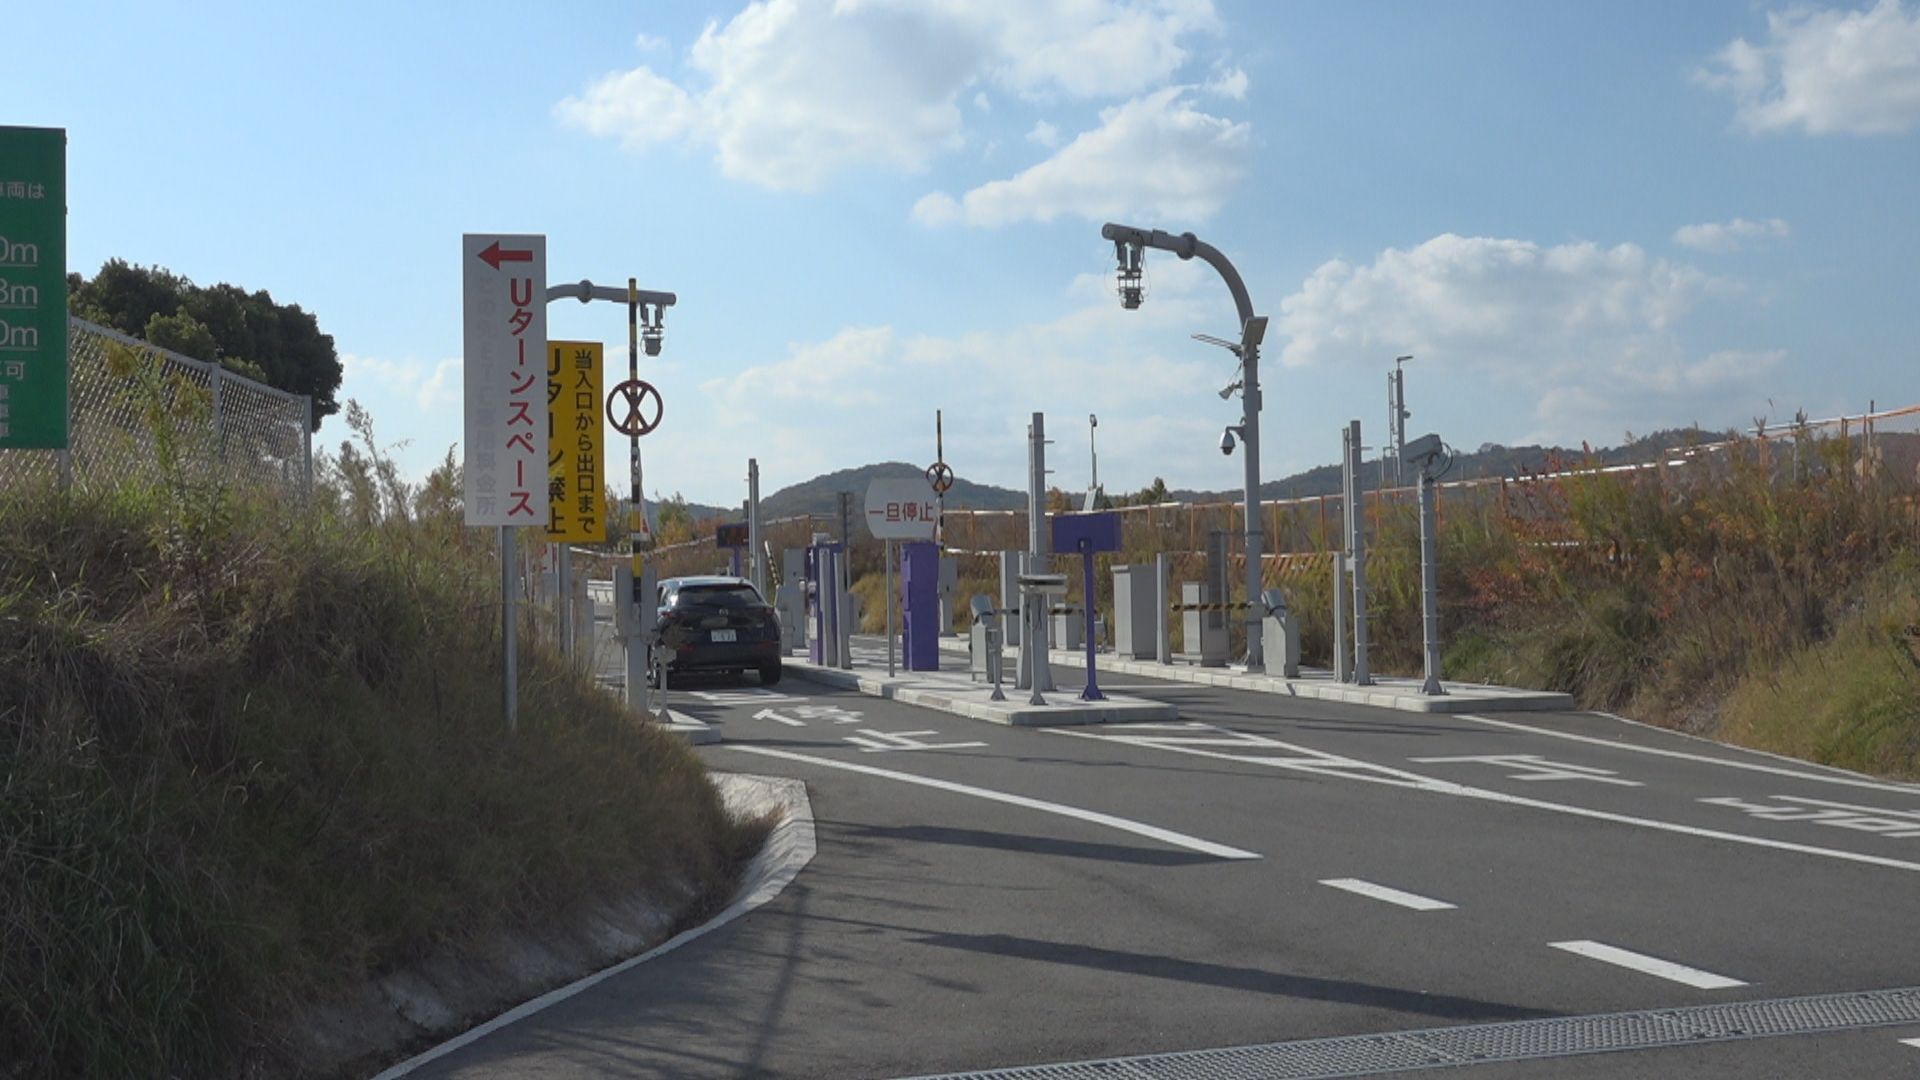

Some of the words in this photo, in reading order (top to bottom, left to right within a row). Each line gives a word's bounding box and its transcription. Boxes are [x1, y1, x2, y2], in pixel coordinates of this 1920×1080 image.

[506, 278, 535, 517] Uターンスペース
[575, 349, 595, 534] 当入口から出口まで
[868, 502, 934, 522] 一旦停止
